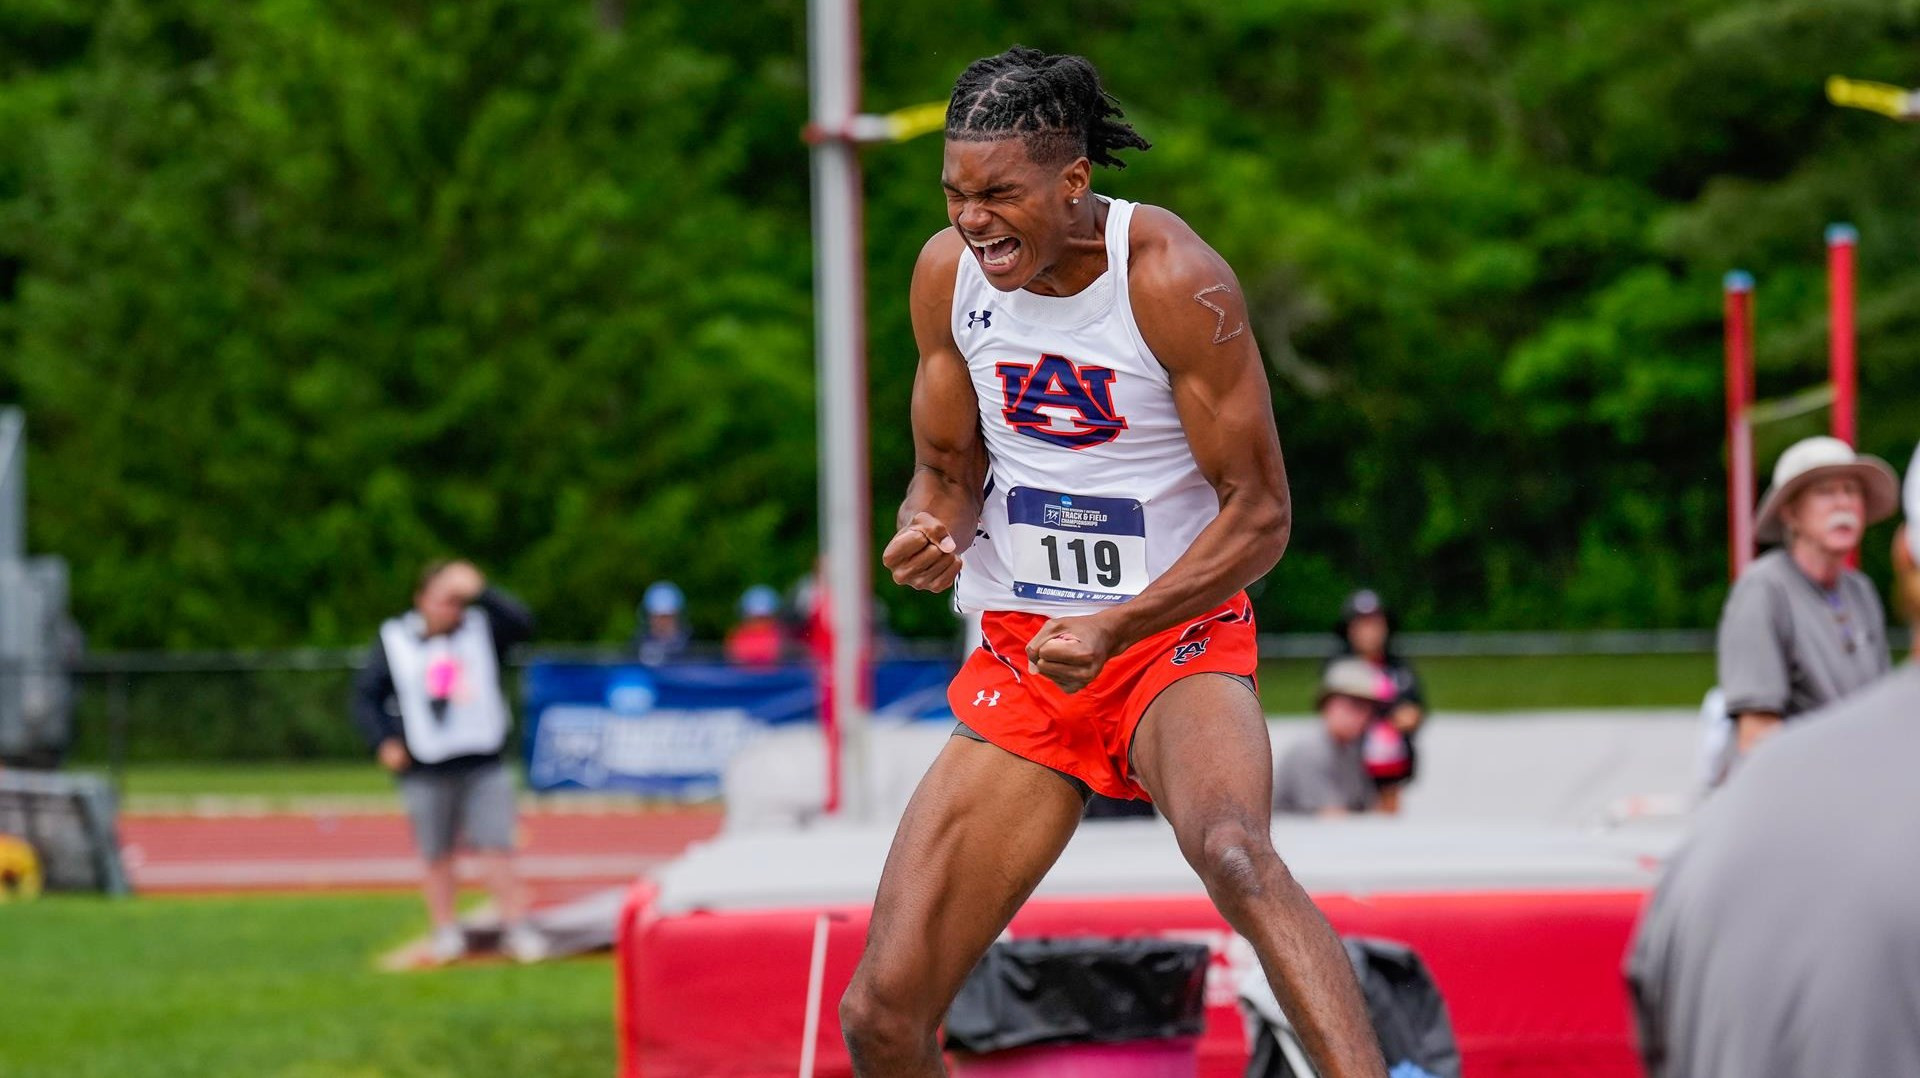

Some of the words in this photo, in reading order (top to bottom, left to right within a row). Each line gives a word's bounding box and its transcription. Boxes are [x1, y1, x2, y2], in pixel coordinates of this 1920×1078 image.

[1061, 511, 1083, 521] TRACK
[1083, 513, 1089, 521] &
[1088, 513, 1108, 522] FIELD
[1040, 535, 1121, 587] 119
